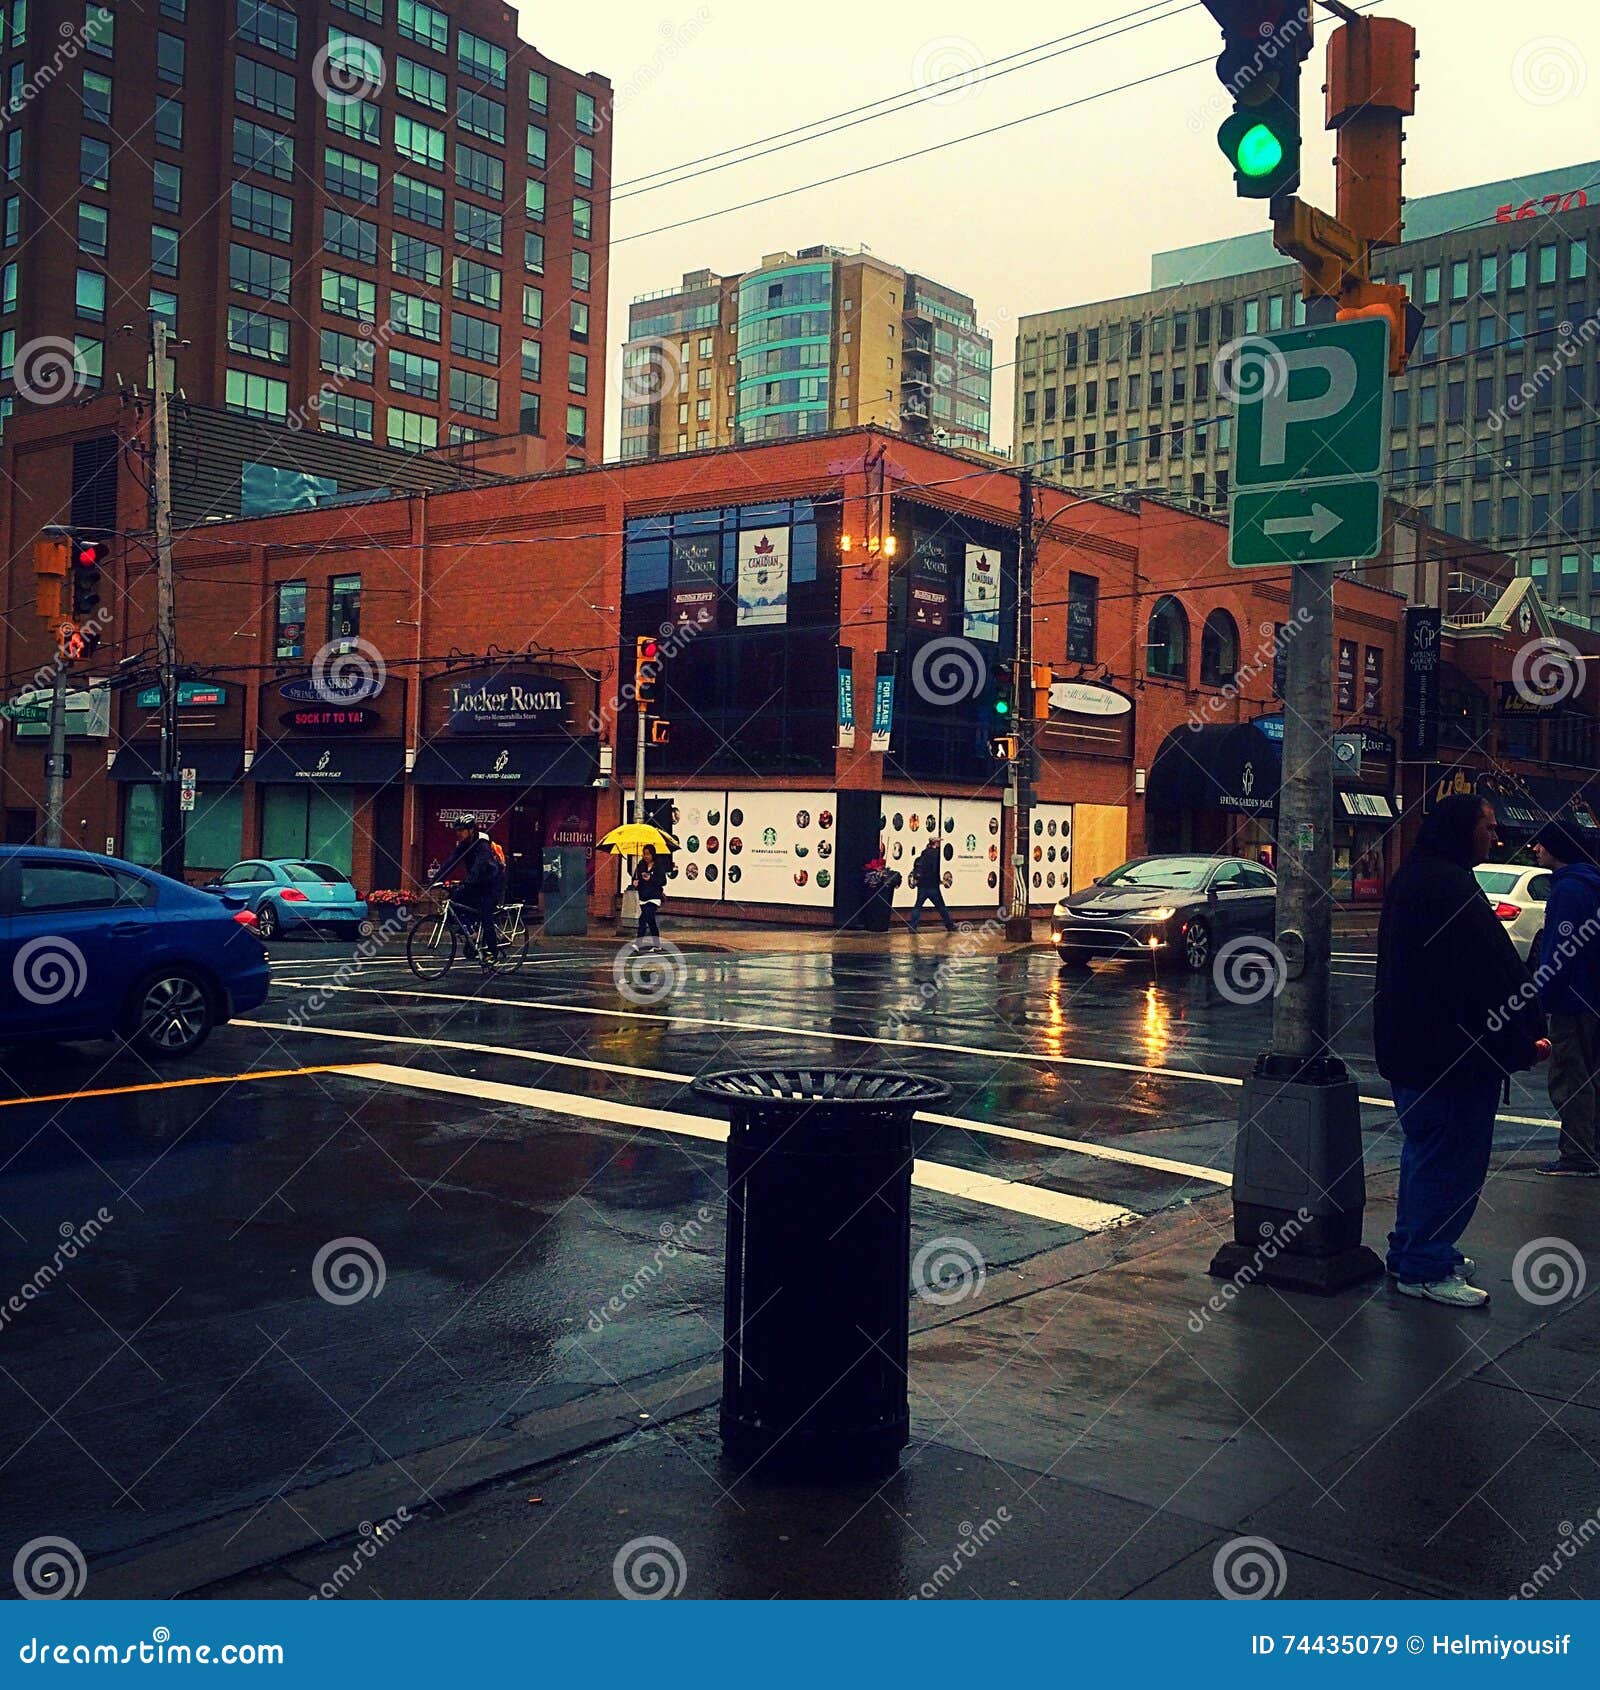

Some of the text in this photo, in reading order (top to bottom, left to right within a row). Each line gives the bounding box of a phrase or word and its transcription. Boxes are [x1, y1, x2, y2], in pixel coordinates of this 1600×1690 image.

[1496, 189, 1588, 223] 5670
[1260, 346, 1358, 467] P
[686, 559, 716, 573] Room
[748, 555, 779, 568] CANADIAN
[1413, 625, 1436, 650] SGP
[308, 679, 326, 690] THE
[452, 685, 562, 712] Locker Room
[881, 681, 891, 725] FOR LEASE
[845, 693, 853, 719] LEASE
[294, 711, 363, 724] SOCK IT TO YA!
[1367, 740, 1385, 751] CRAFT
[1219, 795, 1274, 809] SPRING GARDEN PLACE
[440, 809, 466, 823] Bubb
